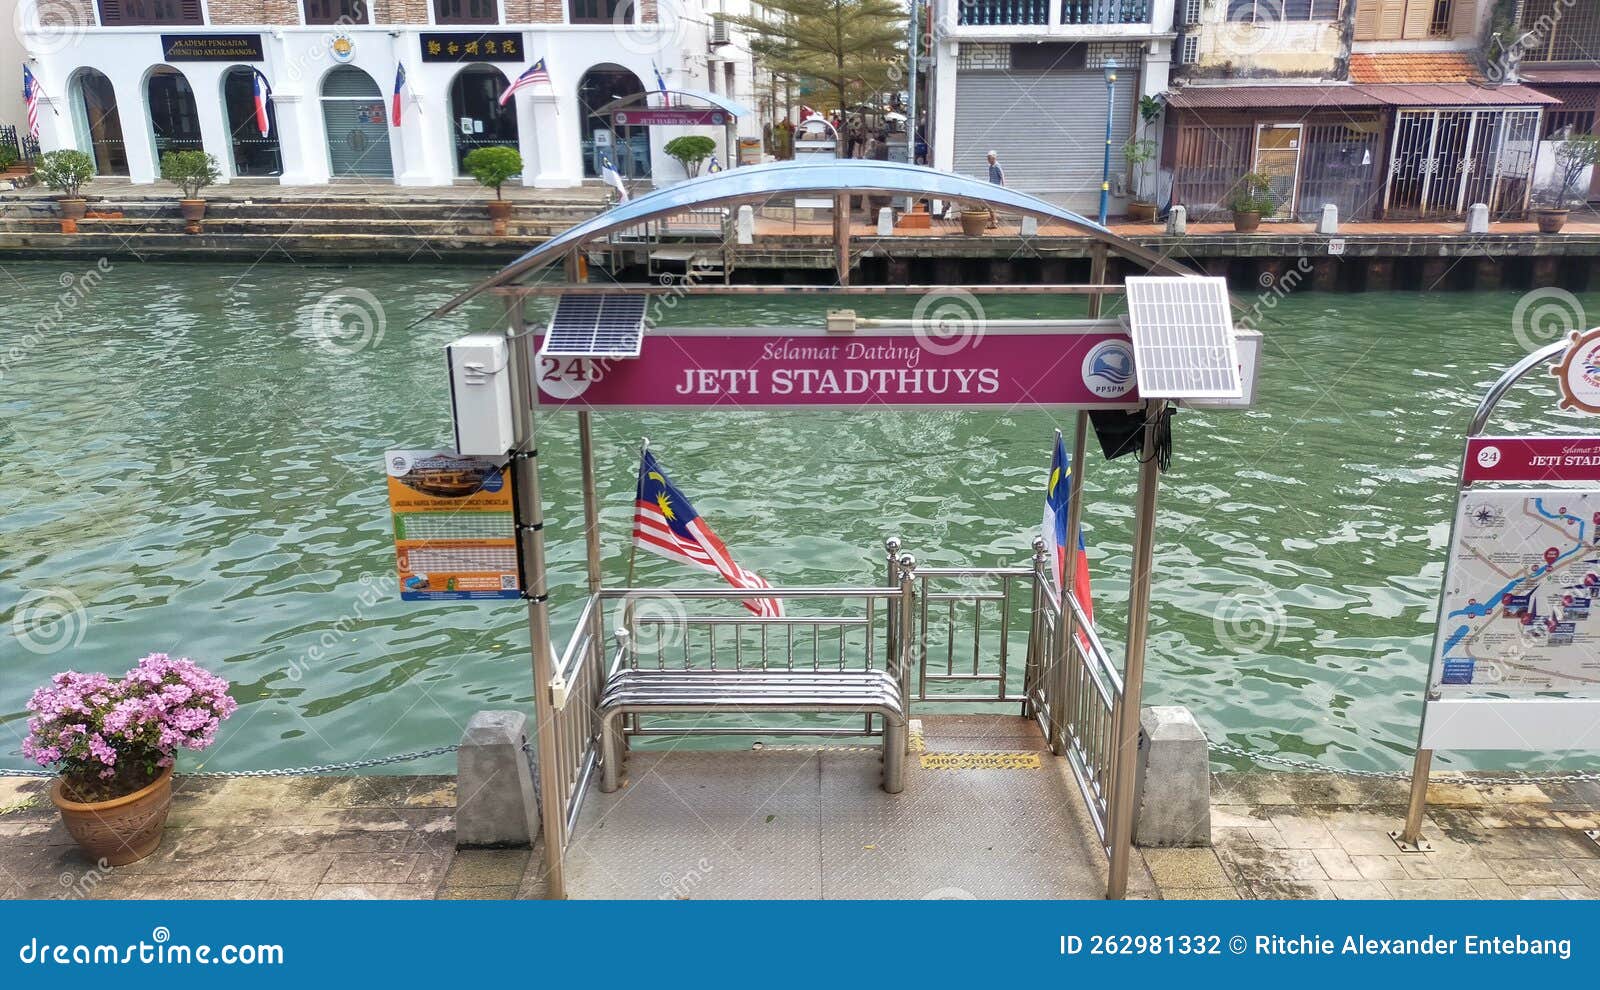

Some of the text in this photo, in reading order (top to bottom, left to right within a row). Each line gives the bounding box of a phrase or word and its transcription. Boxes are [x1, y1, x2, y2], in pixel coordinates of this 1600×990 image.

[761, 338, 921, 368] Selamat Datang
[541, 357, 587, 382] 24
[675, 367, 1001, 395] JETI STADTHUYS
[1095, 385, 1126, 393] PPSPM
[1480, 451, 1498, 462] 24
[1528, 455, 1561, 466] JETI
